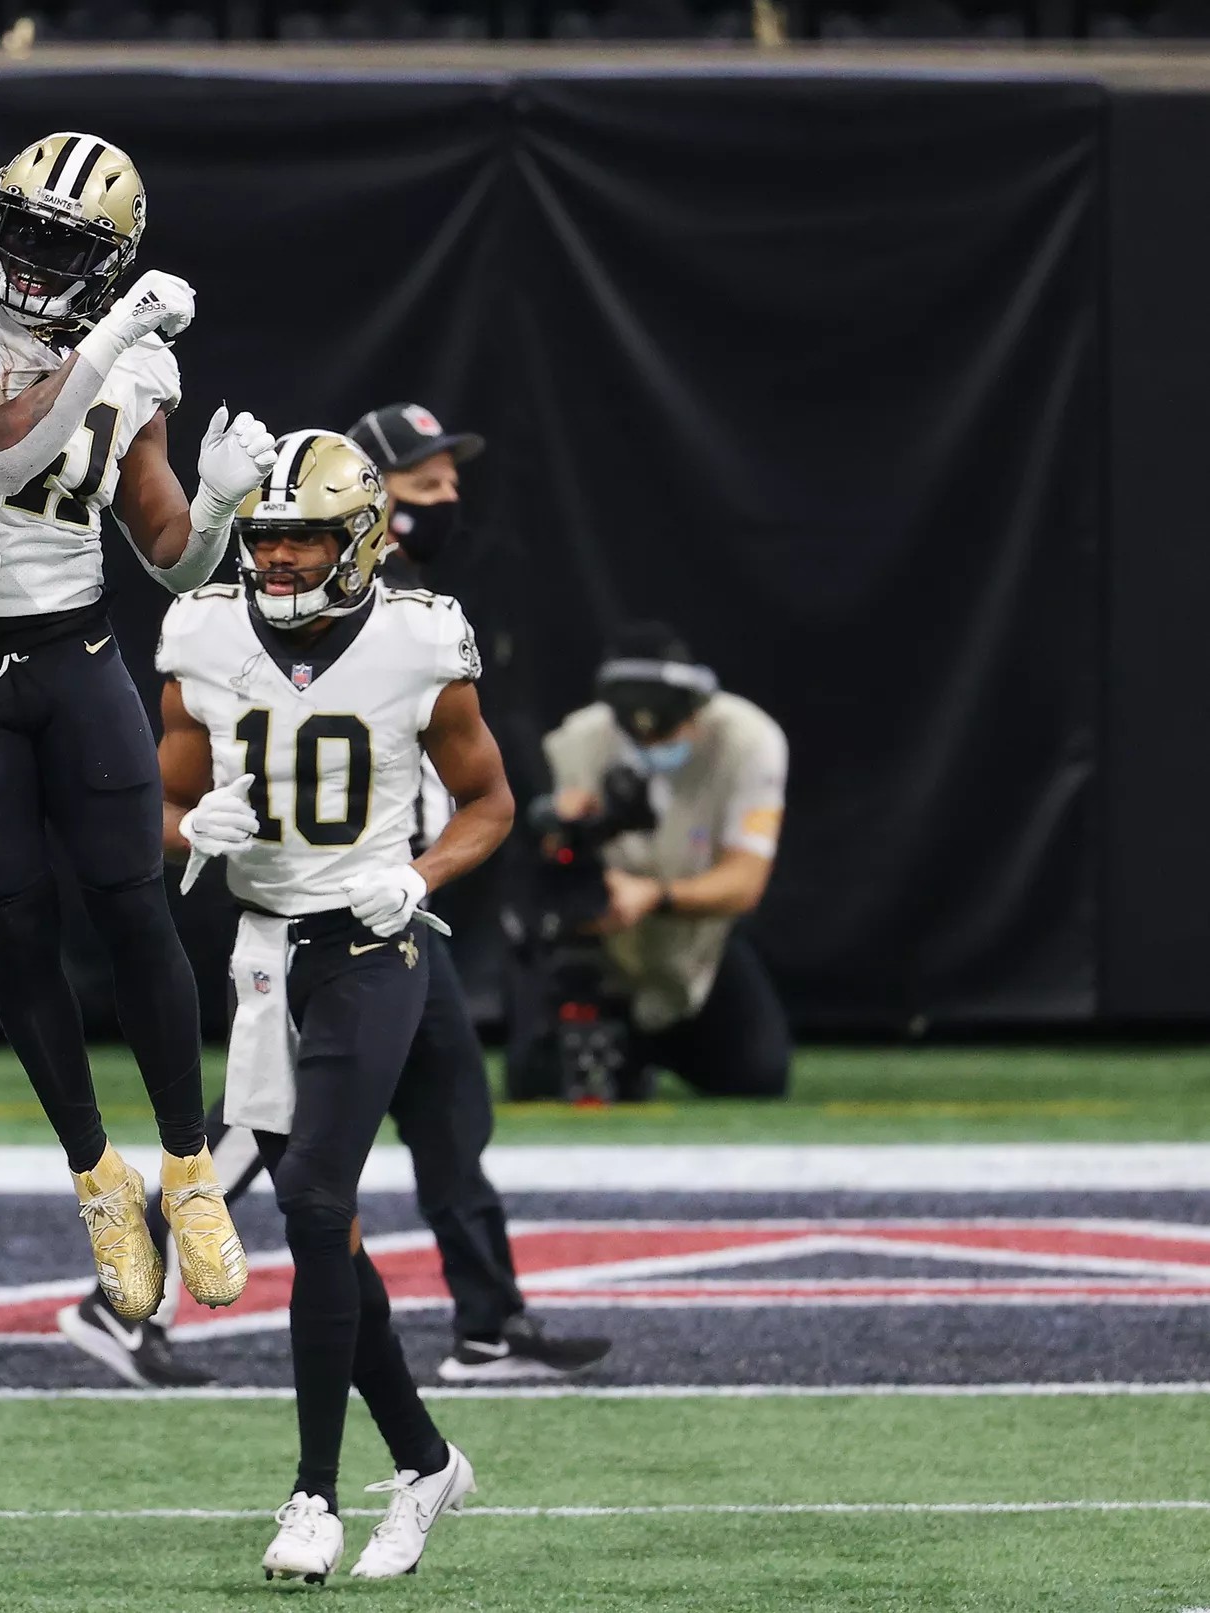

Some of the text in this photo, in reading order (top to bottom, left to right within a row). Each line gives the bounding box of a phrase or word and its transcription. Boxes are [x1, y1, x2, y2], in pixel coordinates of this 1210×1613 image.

[43, 193, 73, 210] SAINTS
[132, 301, 167, 317] adidas
[235, 708, 375, 849] 10
